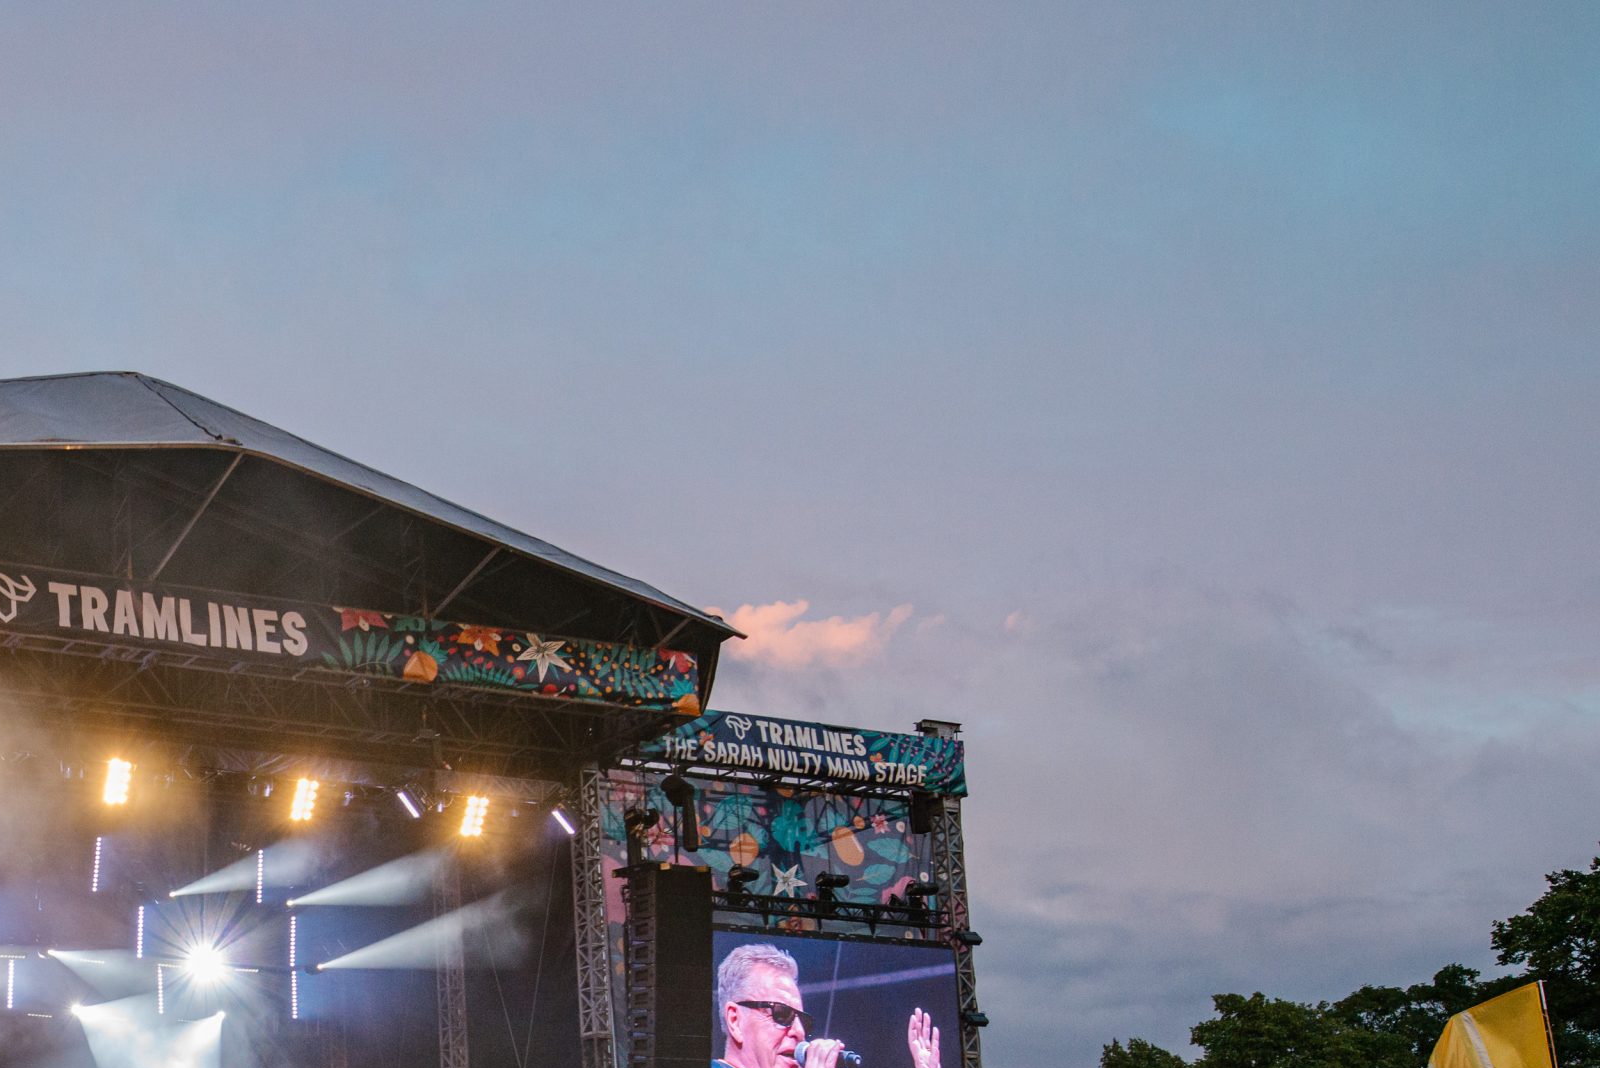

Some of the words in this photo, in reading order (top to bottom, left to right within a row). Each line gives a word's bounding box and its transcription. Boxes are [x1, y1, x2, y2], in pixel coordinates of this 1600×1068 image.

[48, 581, 309, 656] TRAMLINES
[663, 735, 698, 761] THE
[704, 740, 764, 767] SARAH
[767, 747, 821, 775] NULTY
[826, 756, 870, 781] MAIN
[874, 763, 928, 786] STAGE
[755, 720, 867, 756] TRAMLINES
